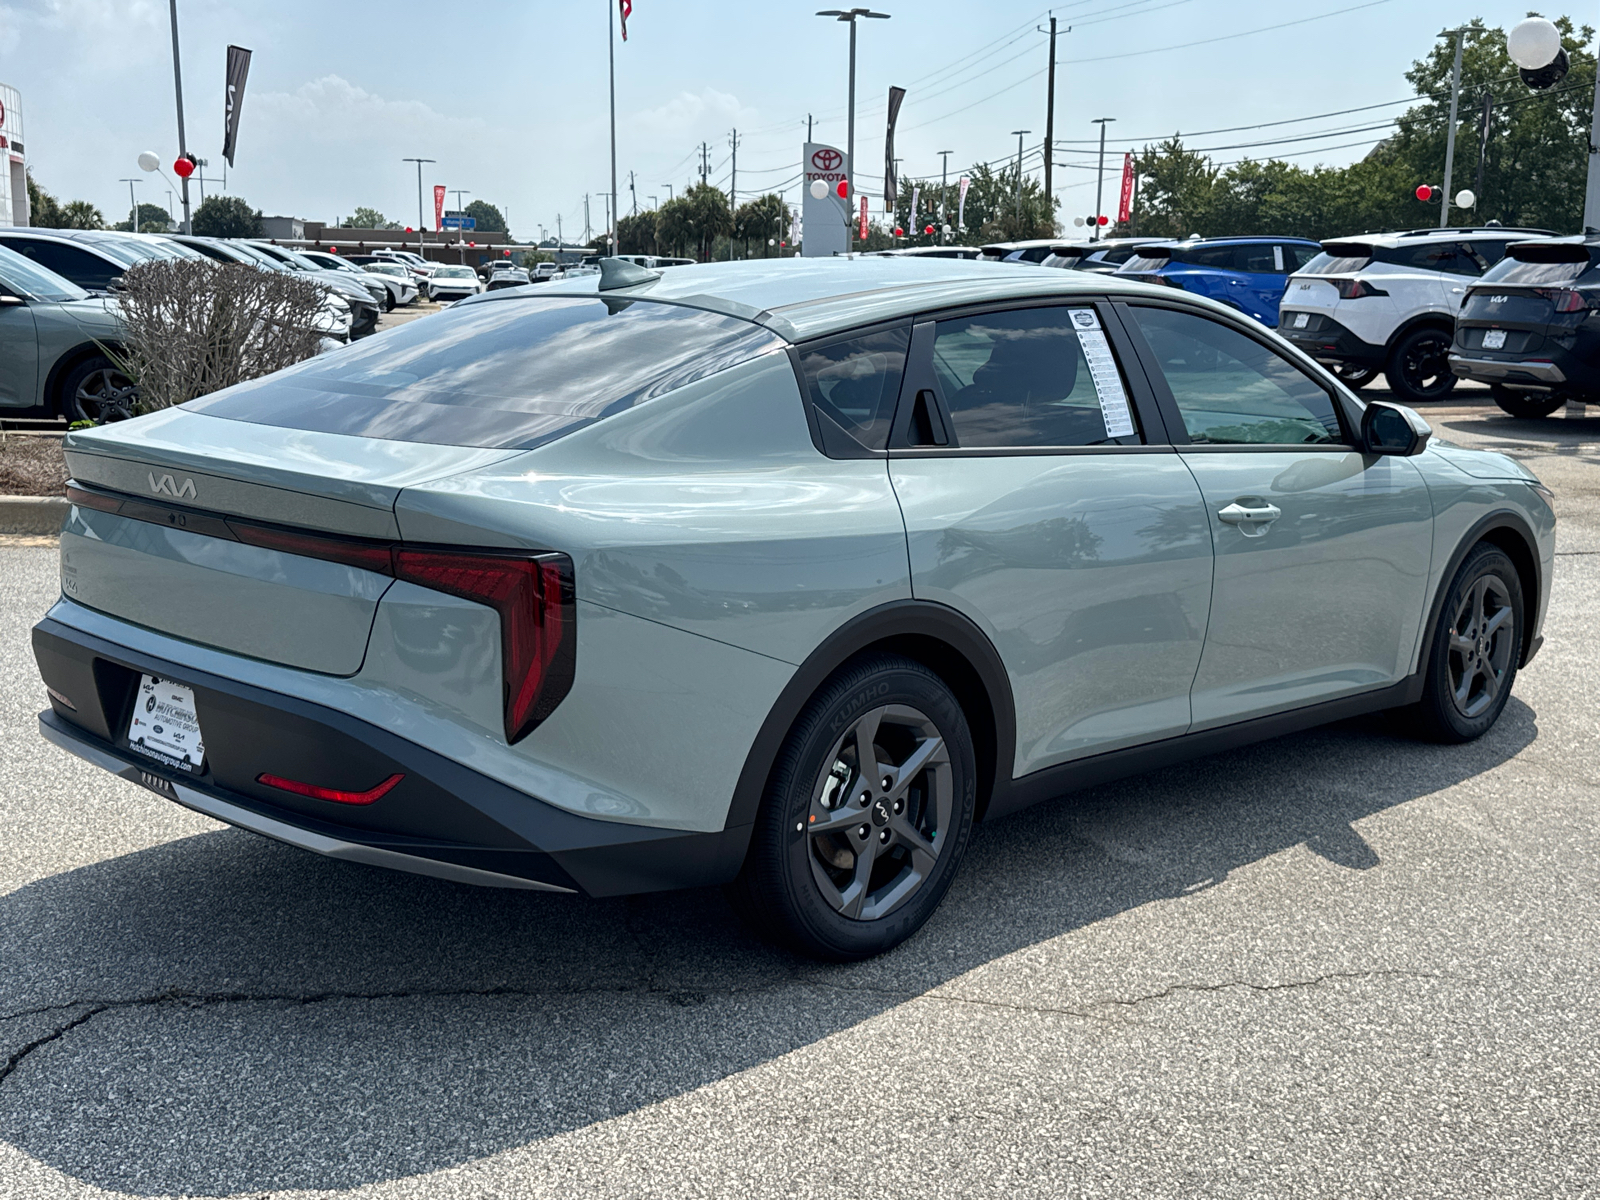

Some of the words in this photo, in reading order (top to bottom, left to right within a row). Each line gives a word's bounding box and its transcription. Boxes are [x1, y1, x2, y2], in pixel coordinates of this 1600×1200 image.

[806, 173, 847, 182] TOYOTA
[1121, 168, 1131, 219] TOYOTA
[1490, 295, 1508, 303] KIA
[148, 471, 198, 500] KIA
[829, 682, 890, 733] KUMHO
[154, 714, 182, 729] AUTOMOTIVE
[182, 721, 199, 733] GROUP
[953, 778, 974, 863] SOLUS
